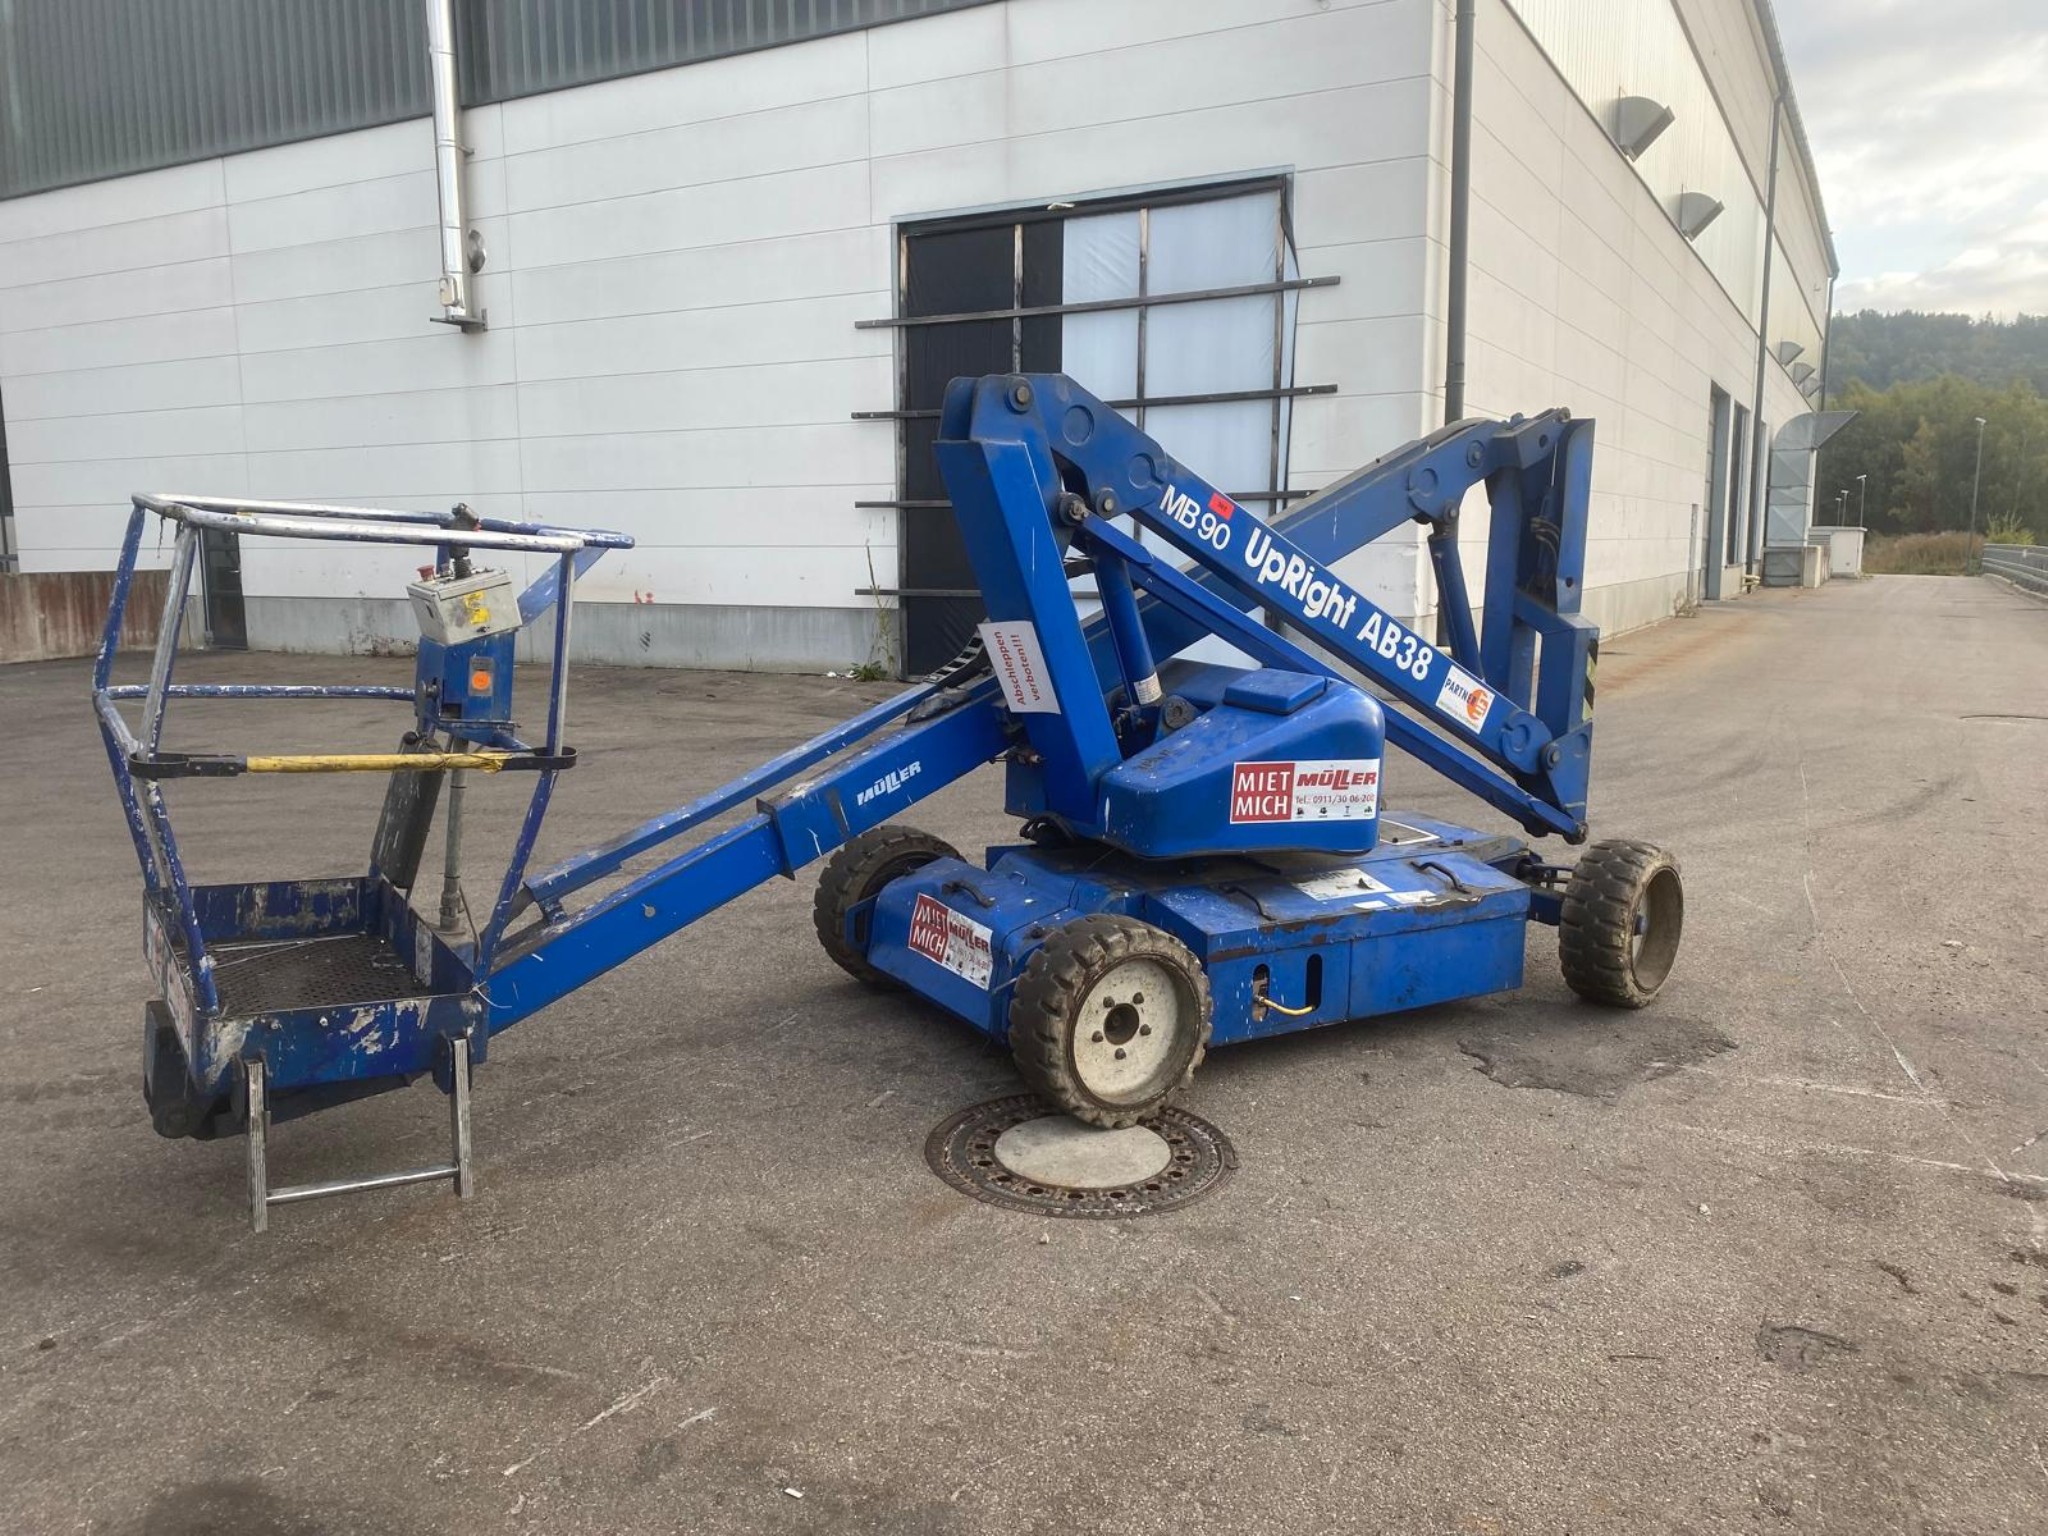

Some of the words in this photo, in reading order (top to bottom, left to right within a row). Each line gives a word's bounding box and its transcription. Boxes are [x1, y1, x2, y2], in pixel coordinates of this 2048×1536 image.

[1245, 528, 1356, 630] UpRight
[1357, 612, 1433, 681] AB38
[994, 631, 1026, 705] Abschleppen
[1010, 634, 1040, 701] verboten!!!
[857, 760, 922, 806] MÜLLER
[1237, 771, 1290, 792] MIET
[1297, 769, 1377, 790] MÜLLER
[1235, 795, 1288, 816] MICH
[916, 904, 947, 932] MIET
[913, 925, 946, 956] MICH
